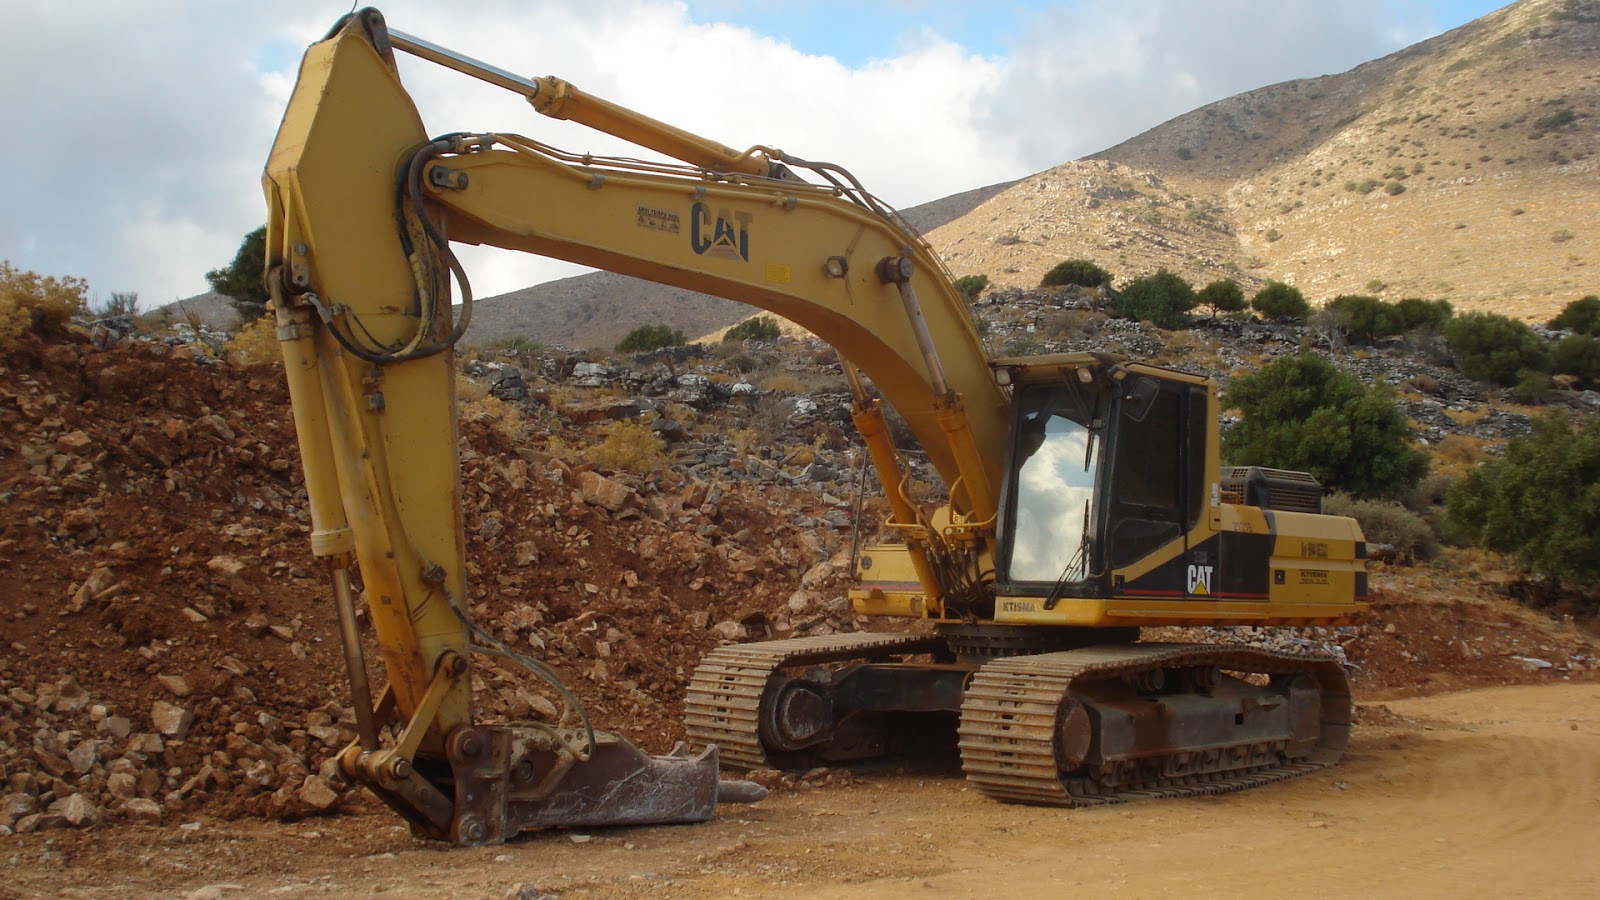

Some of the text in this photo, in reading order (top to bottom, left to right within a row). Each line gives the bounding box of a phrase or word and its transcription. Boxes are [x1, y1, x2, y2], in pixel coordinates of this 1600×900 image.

[691, 202, 753, 262] CAT
[1187, 564, 1213, 594] CAT
[1003, 602, 1035, 612] KTISMA
